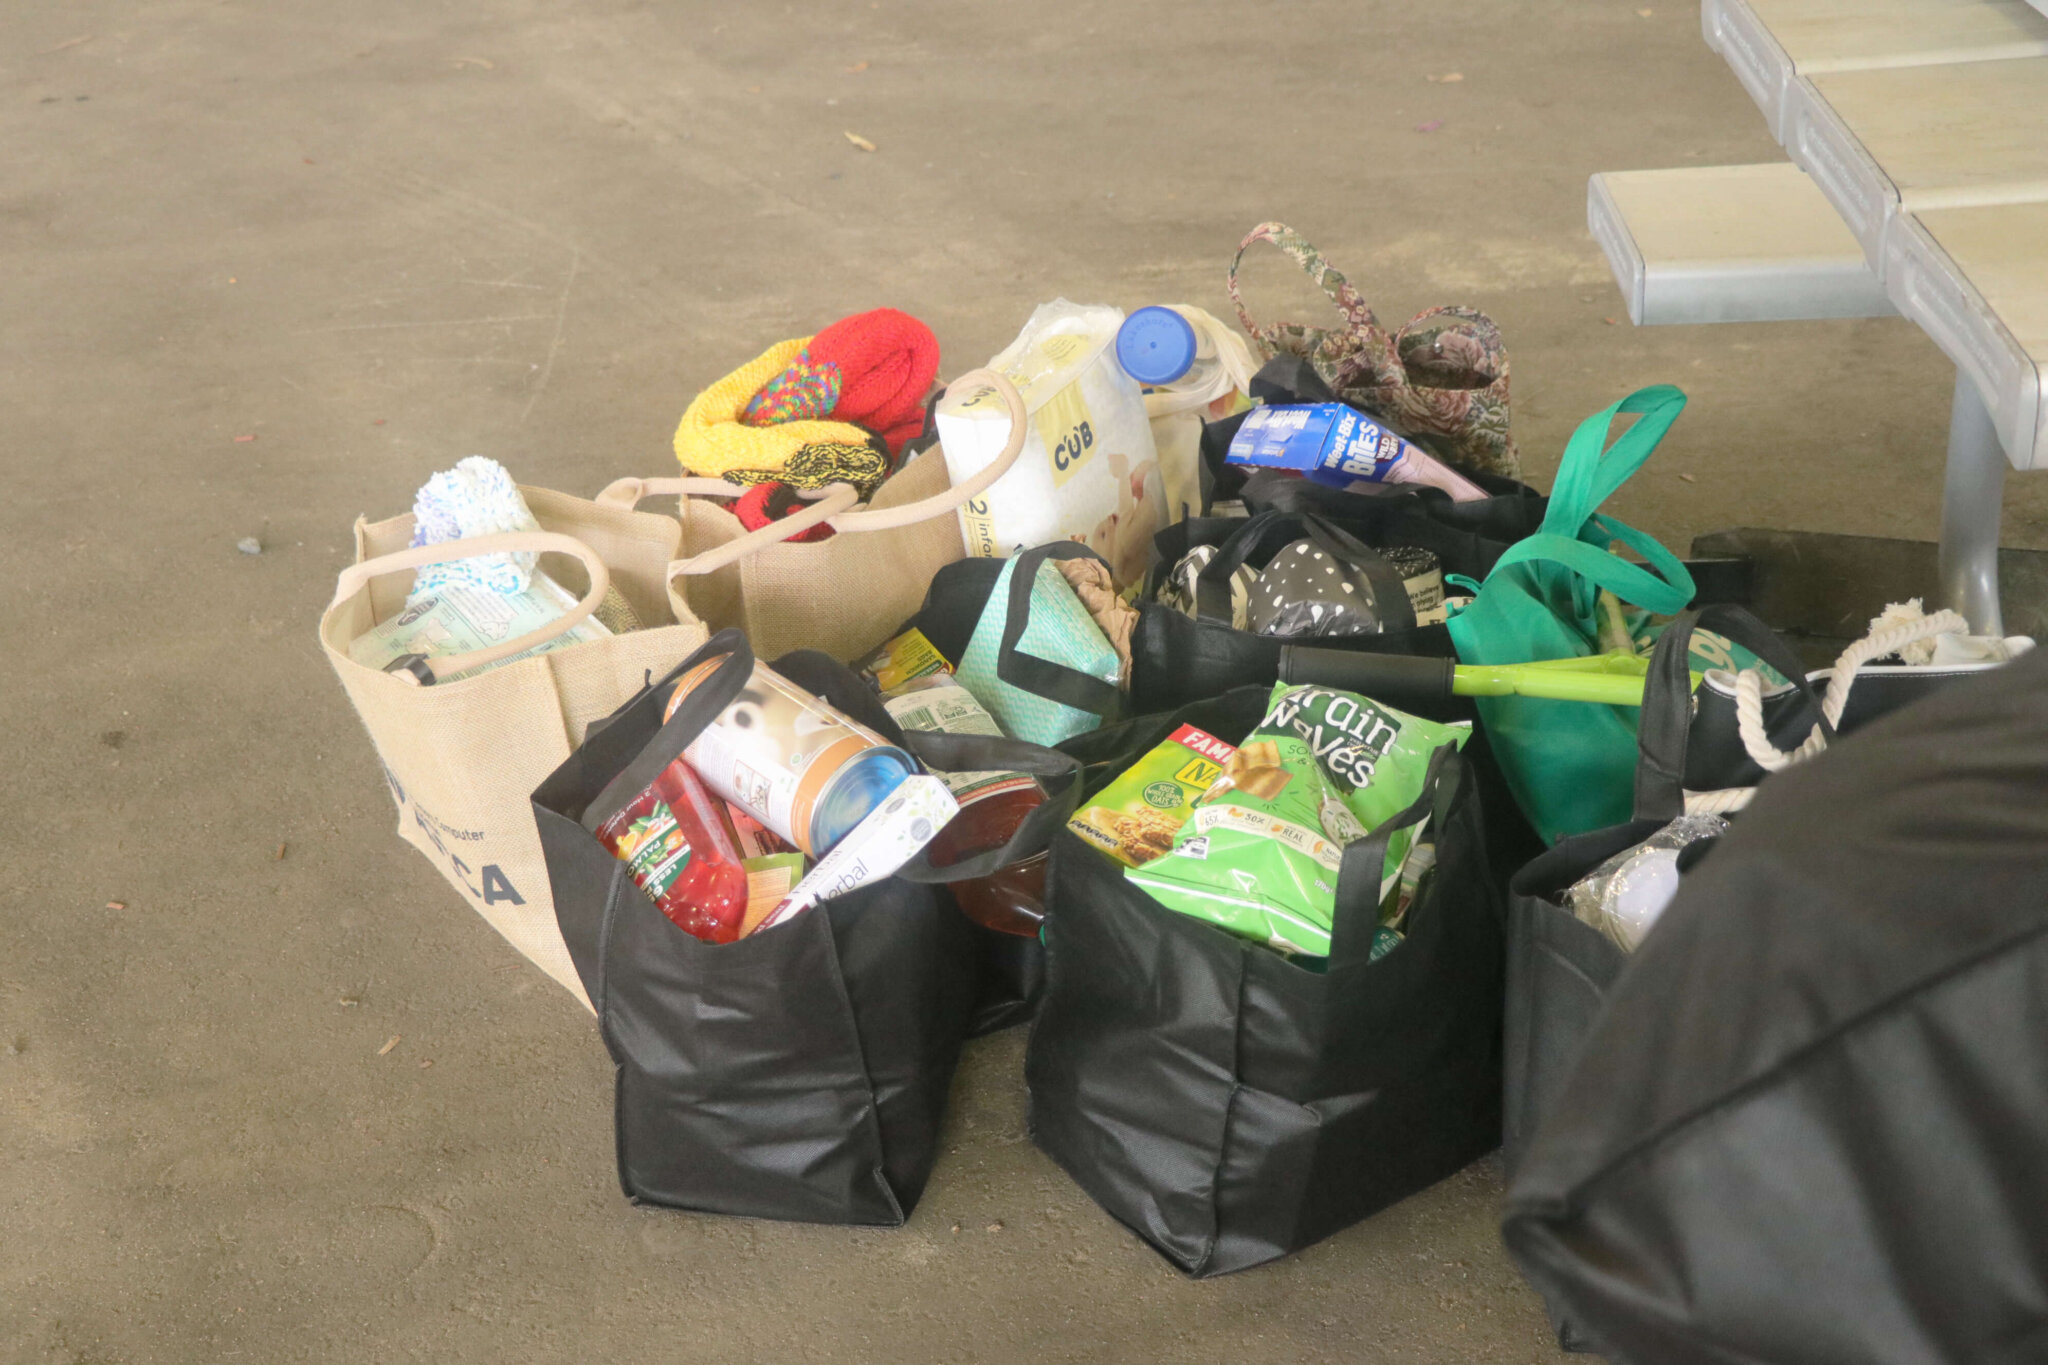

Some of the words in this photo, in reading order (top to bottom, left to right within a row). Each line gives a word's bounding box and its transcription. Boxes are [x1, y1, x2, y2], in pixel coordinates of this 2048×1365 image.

[1054, 421, 1094, 471] CUB
[1324, 412, 1357, 469] Weet-Bix
[1342, 421, 1379, 477] BITES
[1282, 828, 1304, 843] REAL
[827, 857, 870, 901] erbal
